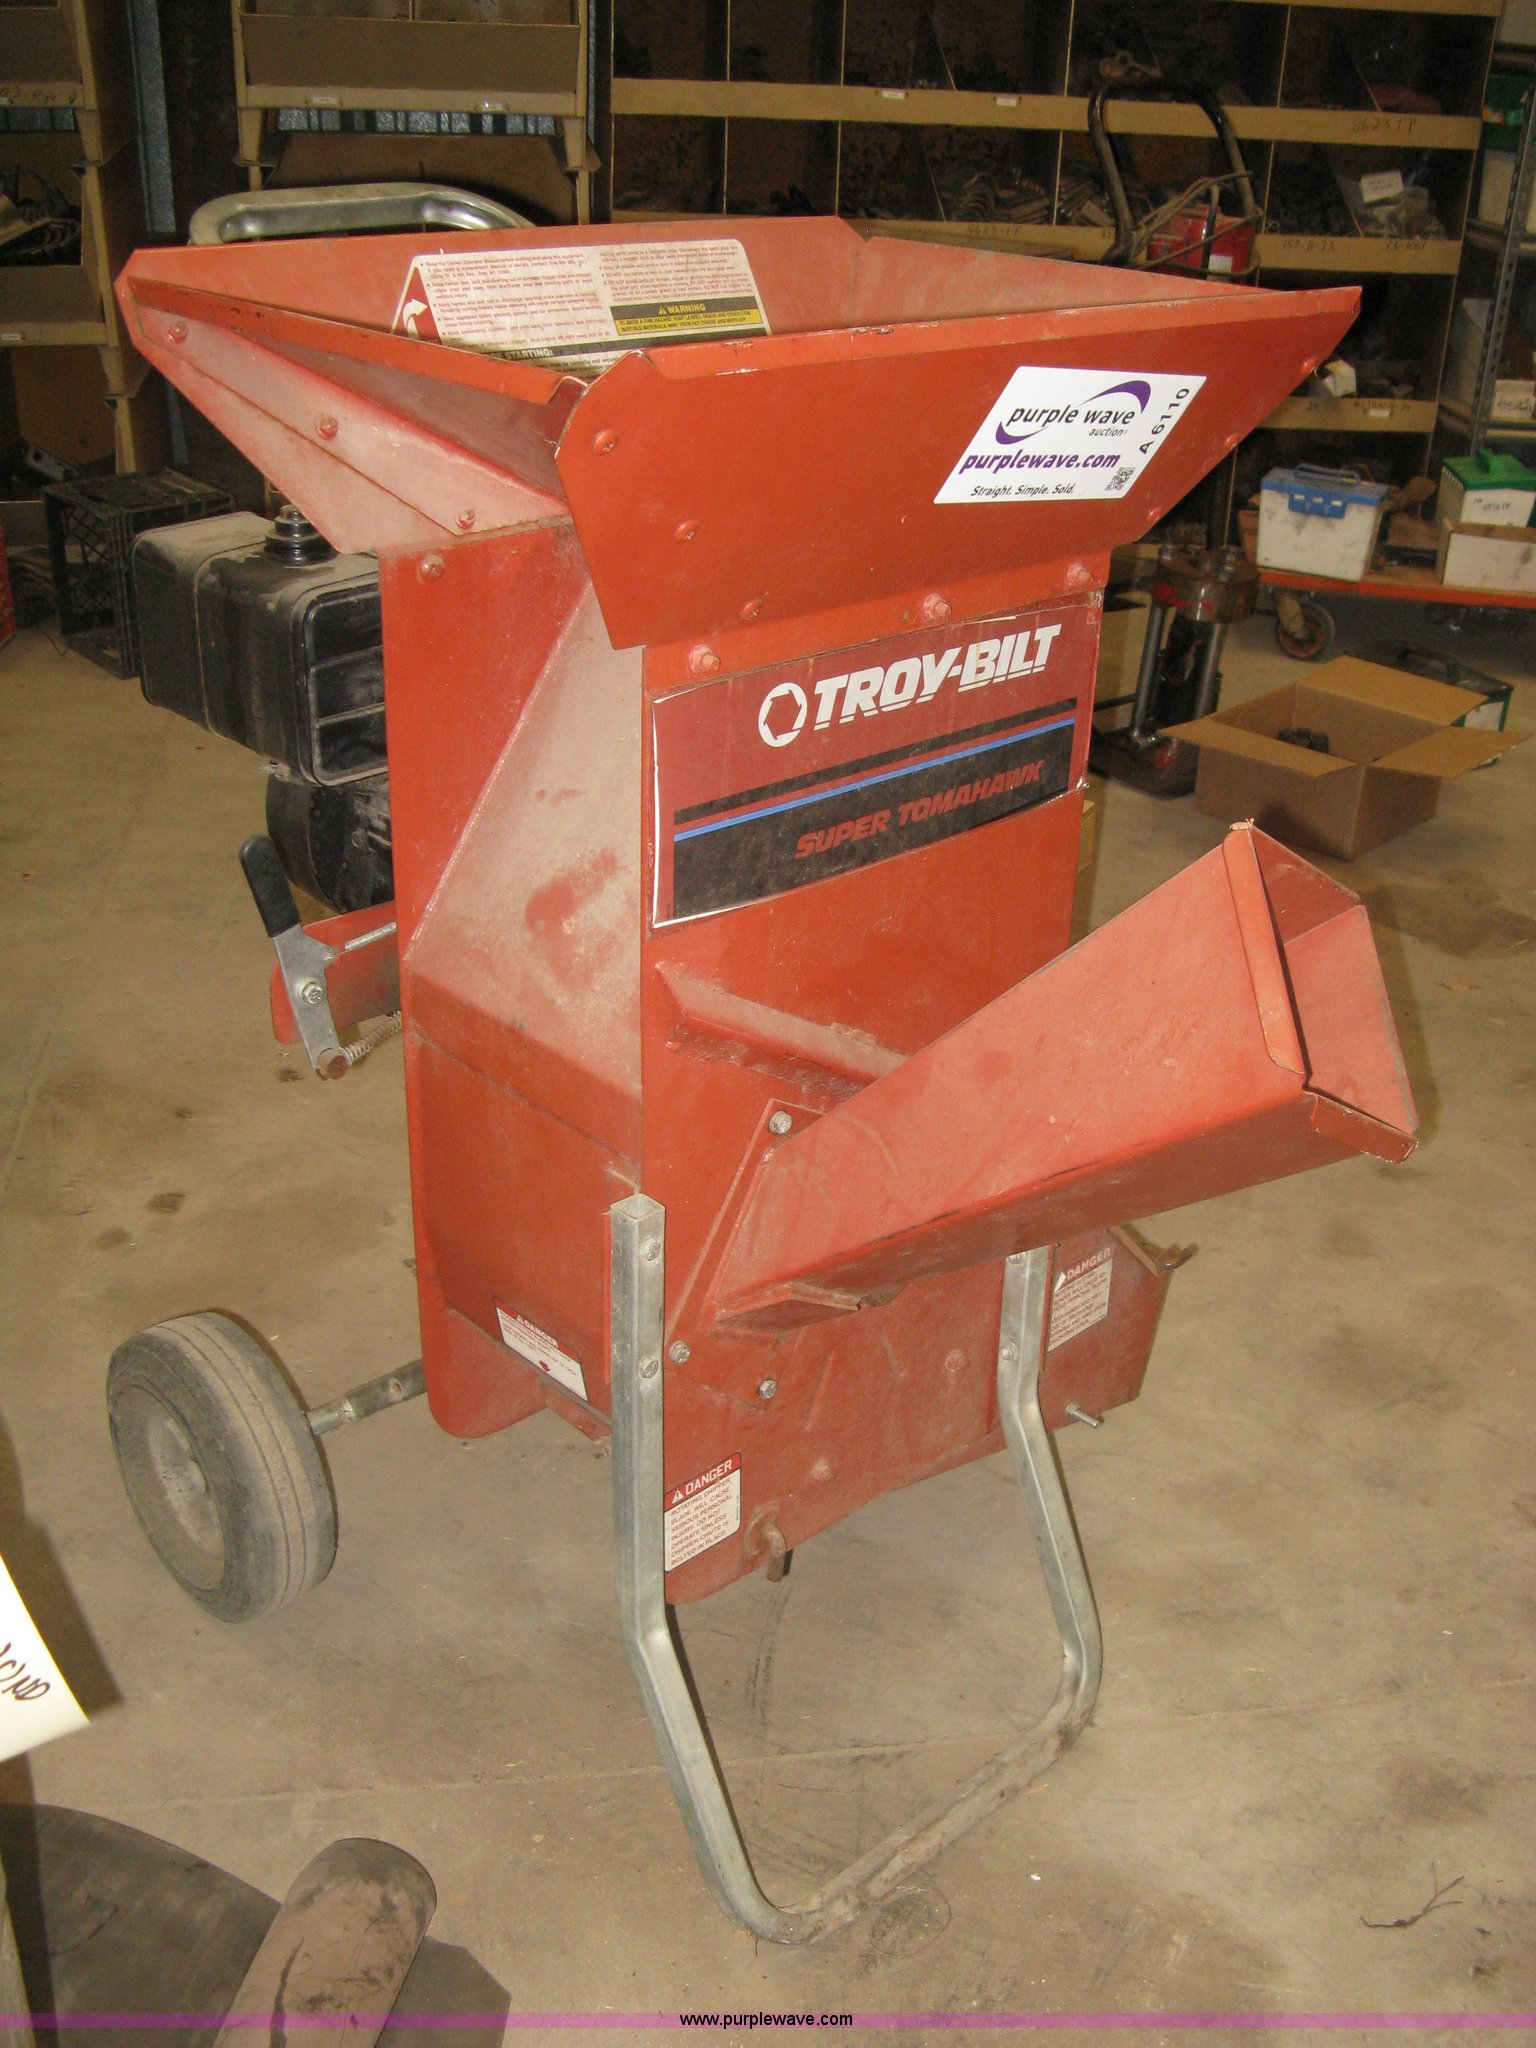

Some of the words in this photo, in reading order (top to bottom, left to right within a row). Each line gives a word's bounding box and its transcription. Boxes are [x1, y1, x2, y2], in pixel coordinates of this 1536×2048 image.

[667, 303, 706, 314] WARNING
[1006, 405, 1079, 427] purple
[1083, 409, 1135, 425] wave
[958, 448, 1120, 475] purplewave.com
[970, 485, 1012, 499] Straight.
[1015, 484, 1049, 497] Simple.
[1052, 483, 1074, 494] Sold.
[813, 623, 1062, 731] TROY-BILT
[795, 810, 892, 859] SUPER
[899, 760, 1045, 827] TOMAHAWK
[1067, 1247, 1111, 1281] DANGER
[685, 1459, 732, 1496] DANGER
[671, 1495, 702, 1516] ROTATING
[671, 1513, 699, 1532] SERIOUS
[700, 1494, 733, 1516] PERSONAL
[708, 1509, 720, 1520] NOT
[671, 1529, 700, 1550] OPERATE
[701, 1513, 727, 1531] UNLESS
[700, 1524, 721, 1540] CHUTE
[671, 1547, 697, 1566] BOLTED
